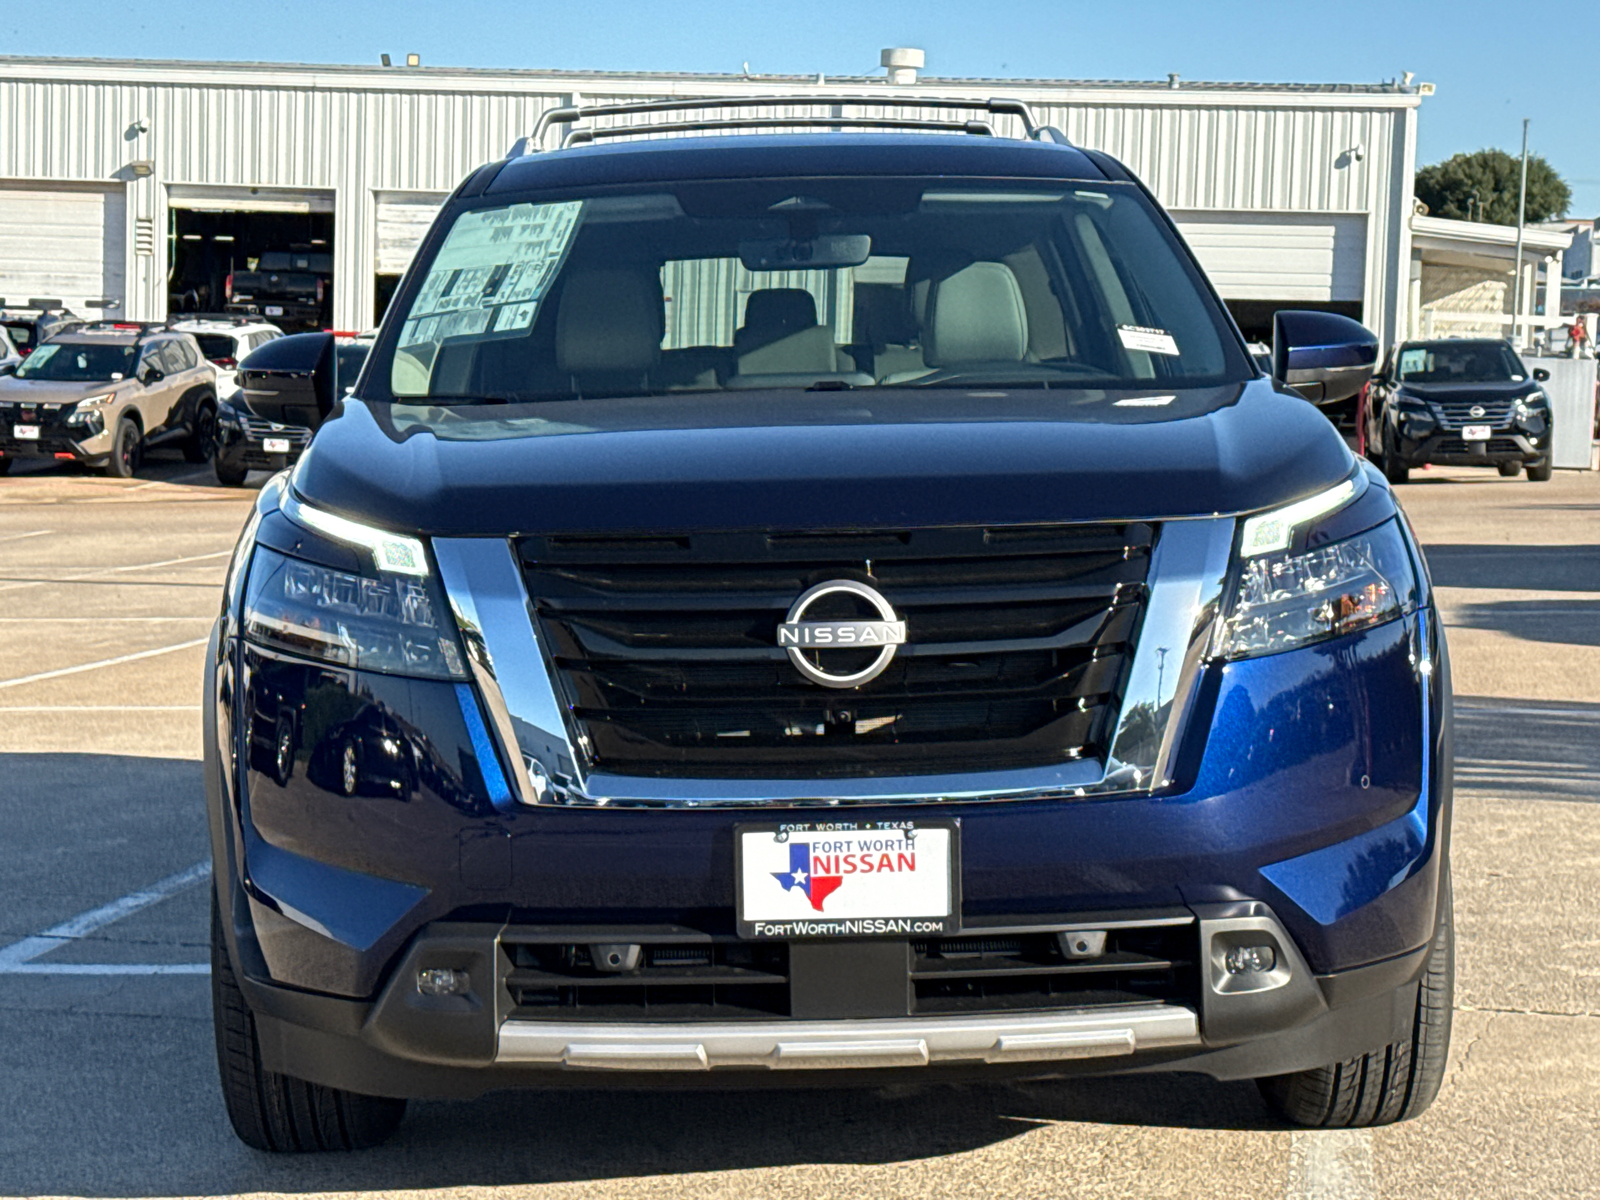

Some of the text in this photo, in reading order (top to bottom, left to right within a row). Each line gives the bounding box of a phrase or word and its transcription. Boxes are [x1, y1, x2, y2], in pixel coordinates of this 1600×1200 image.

[781, 627, 902, 643] NISSAN
[780, 821, 914, 832] FORT WORTH TEXAS
[812, 839, 915, 853] FORT WORTH
[813, 853, 916, 874] NISSAN
